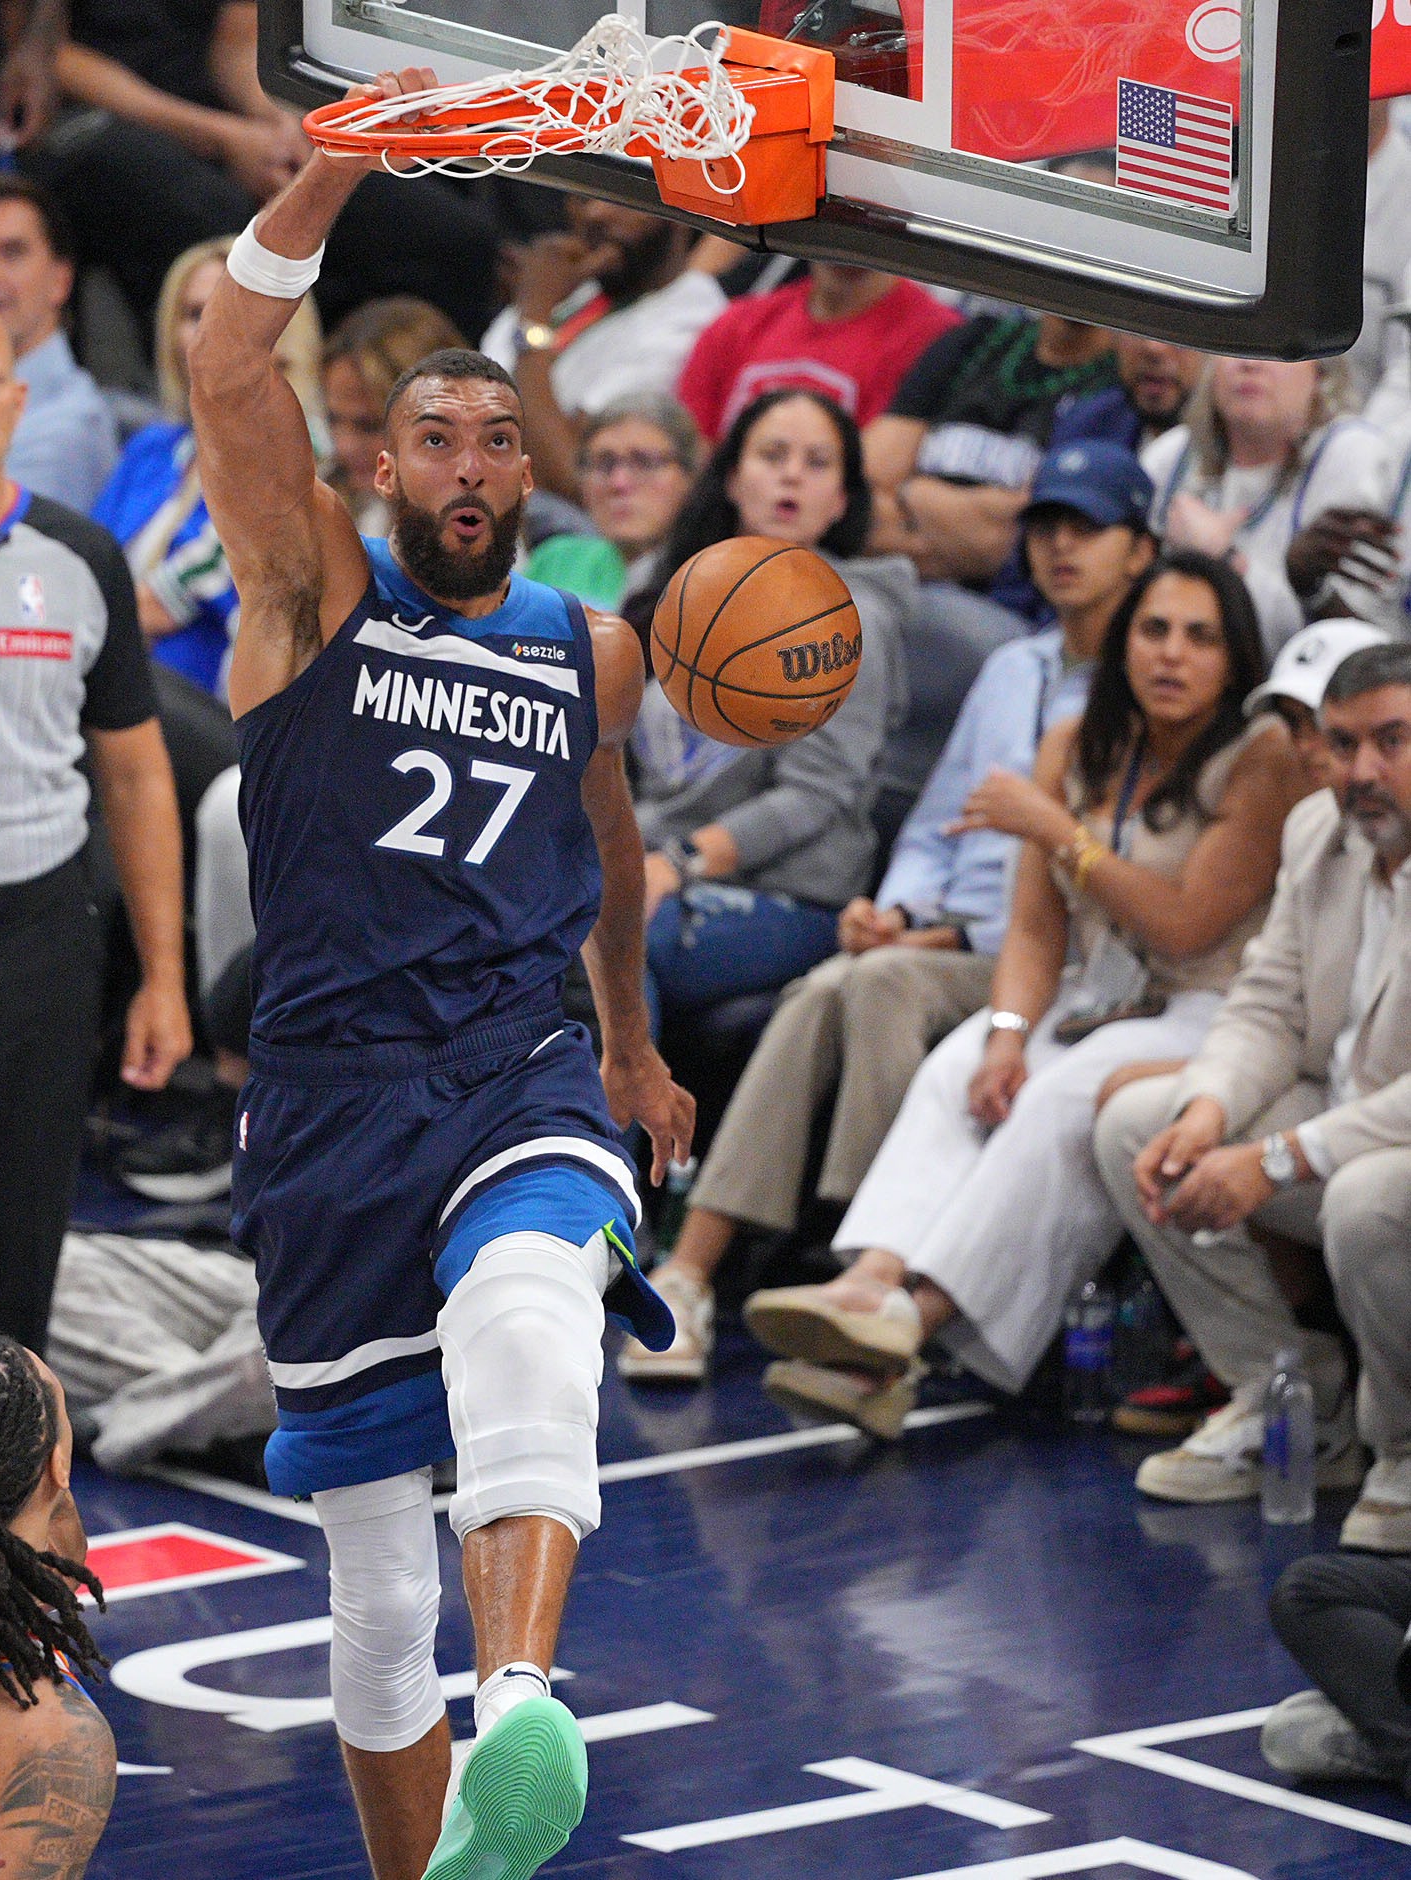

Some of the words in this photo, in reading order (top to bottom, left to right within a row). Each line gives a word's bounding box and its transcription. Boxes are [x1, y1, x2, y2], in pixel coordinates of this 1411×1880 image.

[522, 645, 566, 661] sezzle
[352, 663, 571, 761] MINNESOTA
[372, 747, 538, 866] 27
